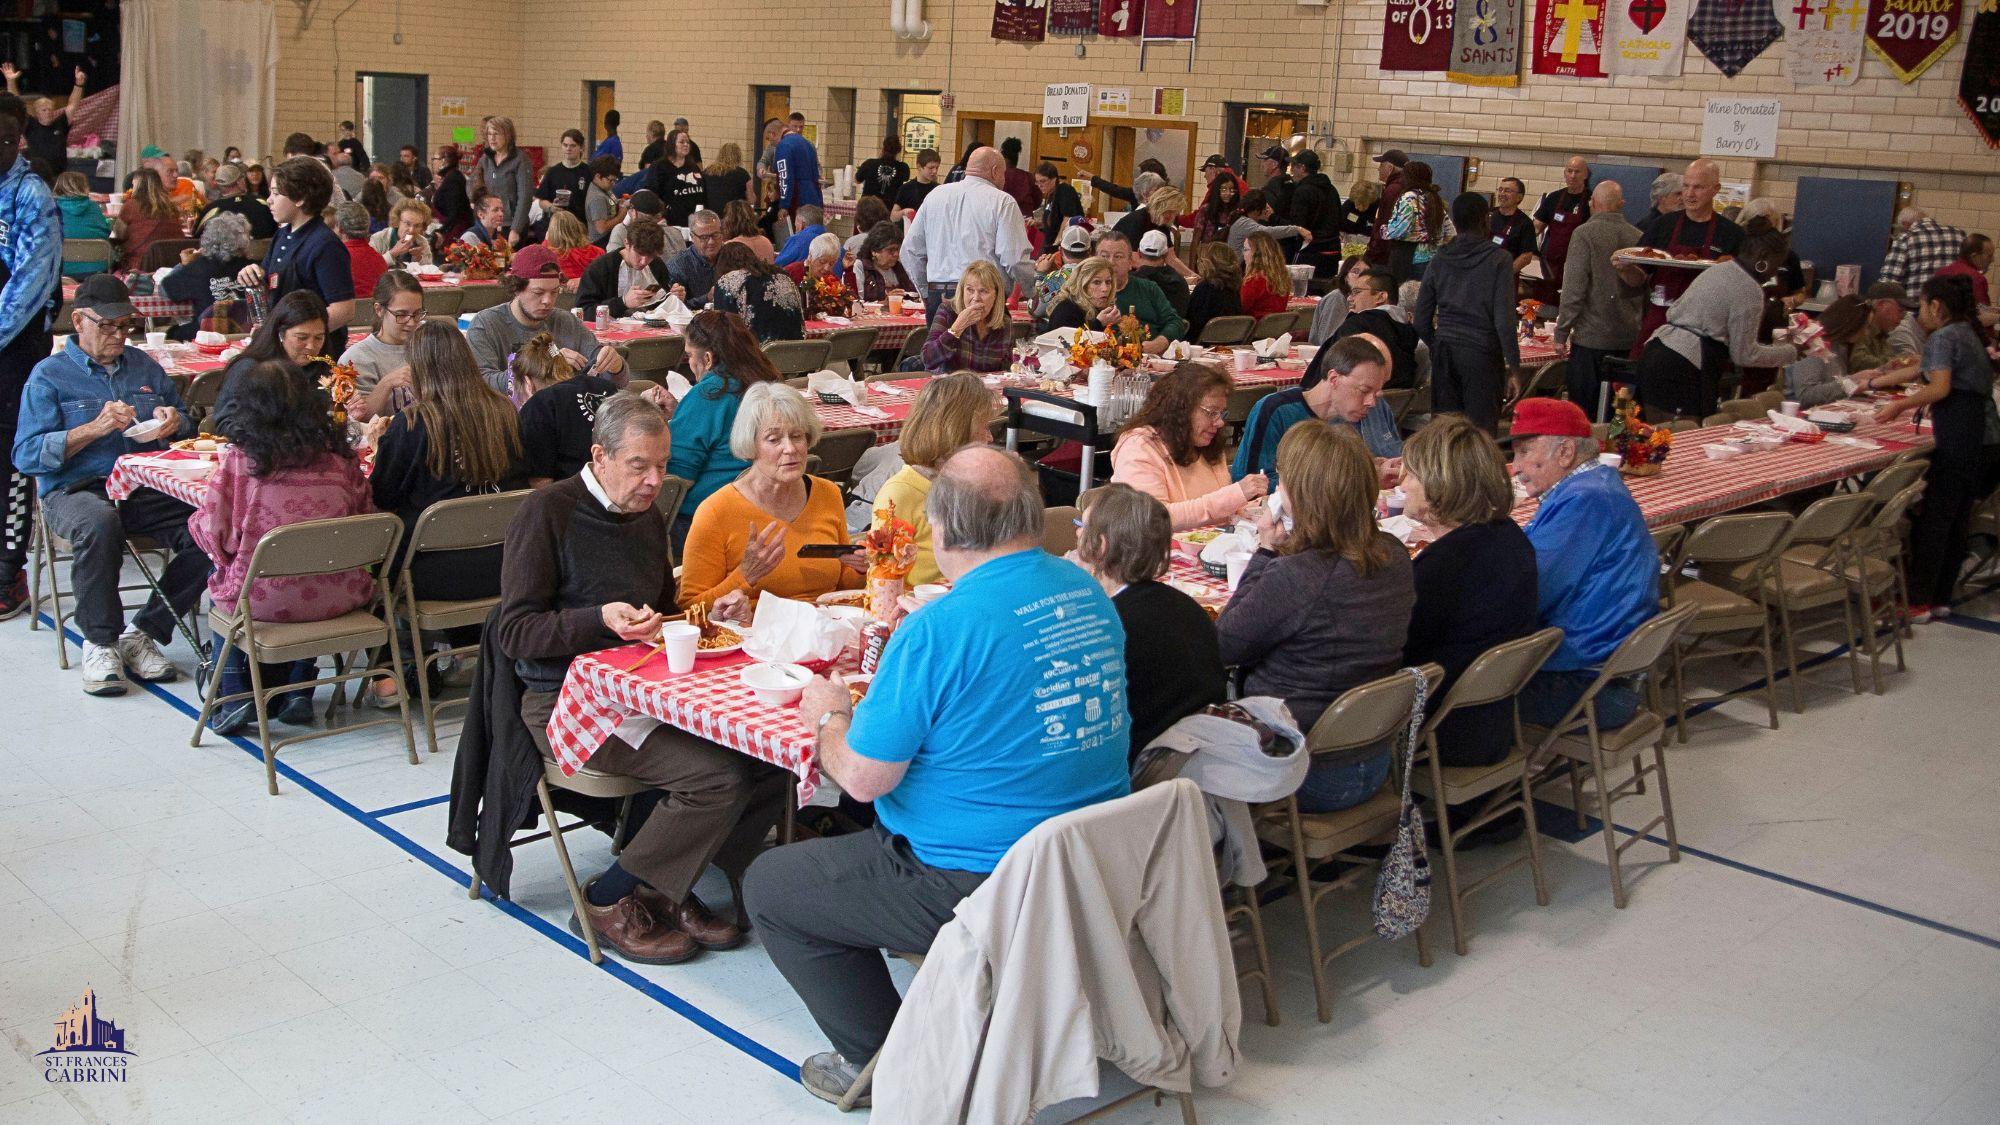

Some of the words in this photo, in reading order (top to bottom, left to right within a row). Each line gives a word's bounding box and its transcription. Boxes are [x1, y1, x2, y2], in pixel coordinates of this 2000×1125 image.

[1391, 11, 1408, 24] OF
[1435, 14, 1453, 29] 13
[1877, 13, 1949, 40] 2019
[1461, 47, 1515, 64] SAINTS
[1555, 66, 1577, 75] FAITH
[1046, 87, 1063, 97] BREAD
[1064, 85, 1088, 95] DONATED
[1062, 101, 1069, 110] BY
[1708, 102, 1732, 115] Wine
[1733, 102, 1776, 116] Donated
[1063, 115, 1082, 124] BAKERY
[1733, 120, 1746, 136] By
[1716, 136, 1743, 153] Barry
[1014, 601, 1040, 616] WALK
[1040, 596, 1056, 608] FOR
[861, 635, 882, 675] Pibb
